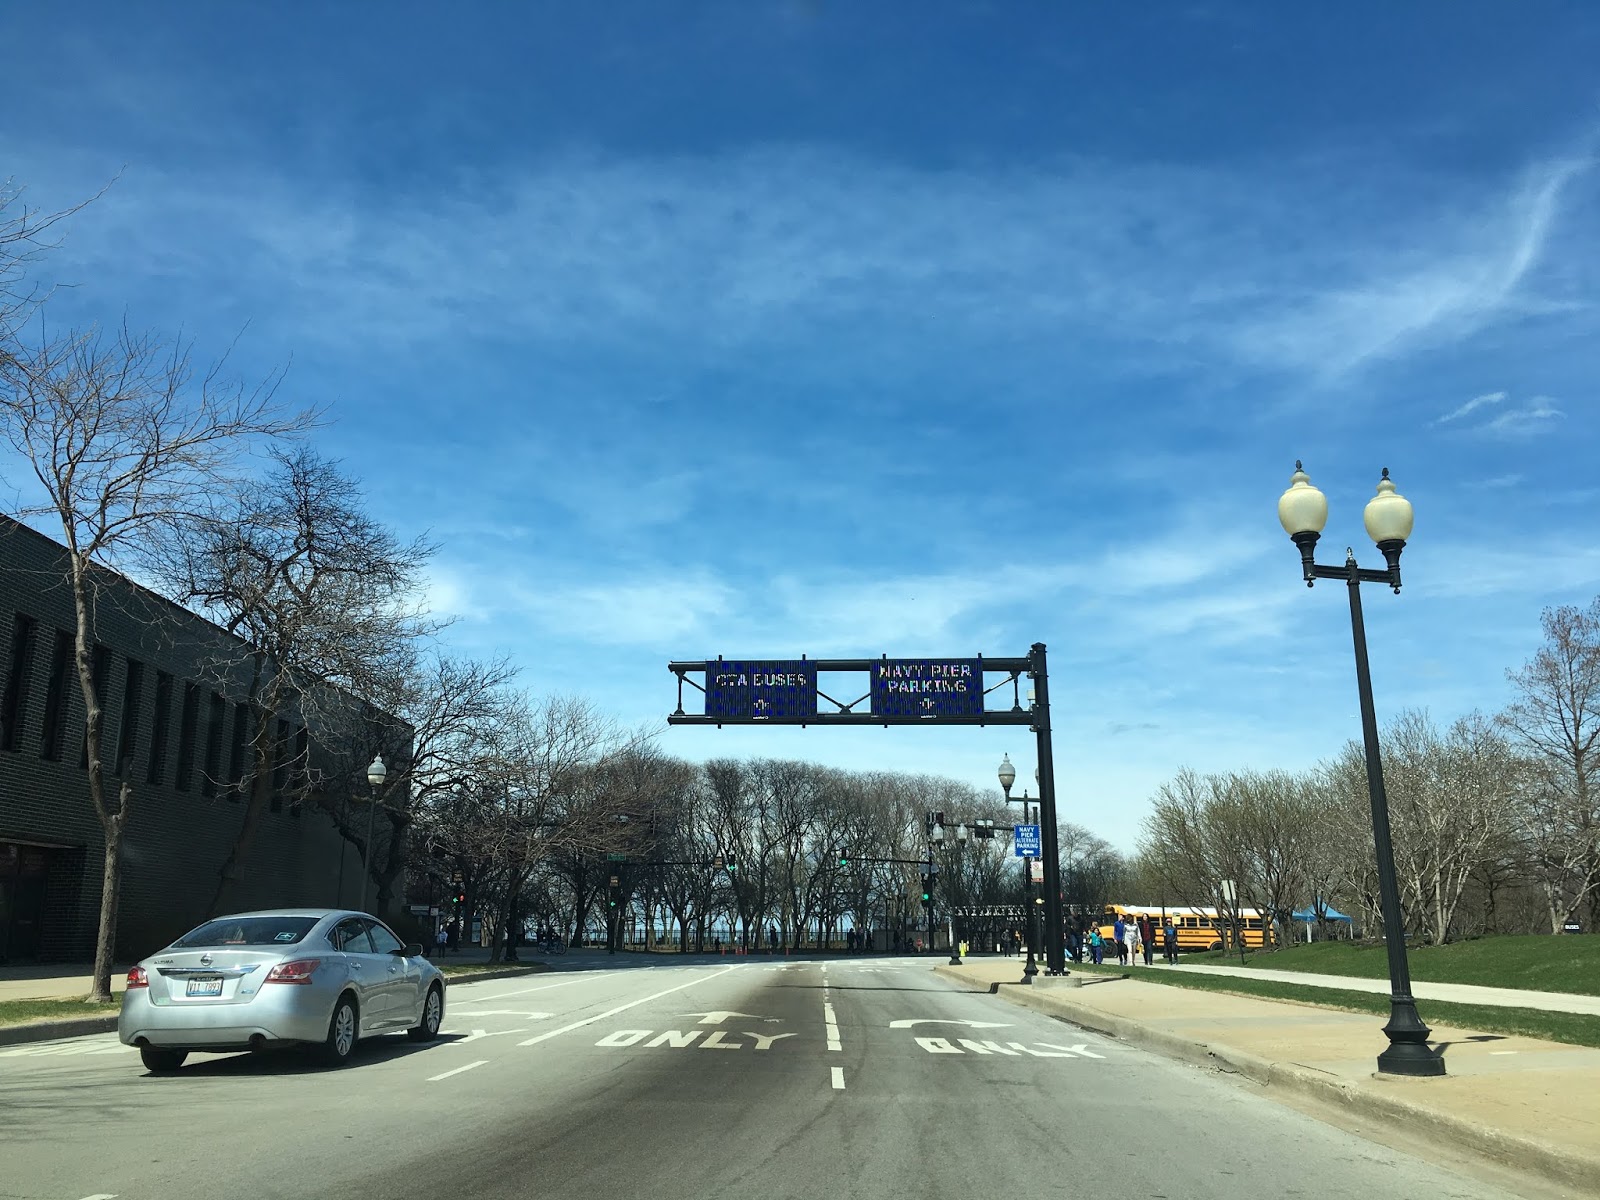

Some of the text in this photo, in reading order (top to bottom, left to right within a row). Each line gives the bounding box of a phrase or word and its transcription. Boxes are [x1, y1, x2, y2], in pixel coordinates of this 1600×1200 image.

[879, 664, 972, 677] NAVY PIER
[888, 679, 967, 693] PARKING
[595, 1029, 798, 1051] ONLY
[915, 1037, 1107, 1060] ONLY
